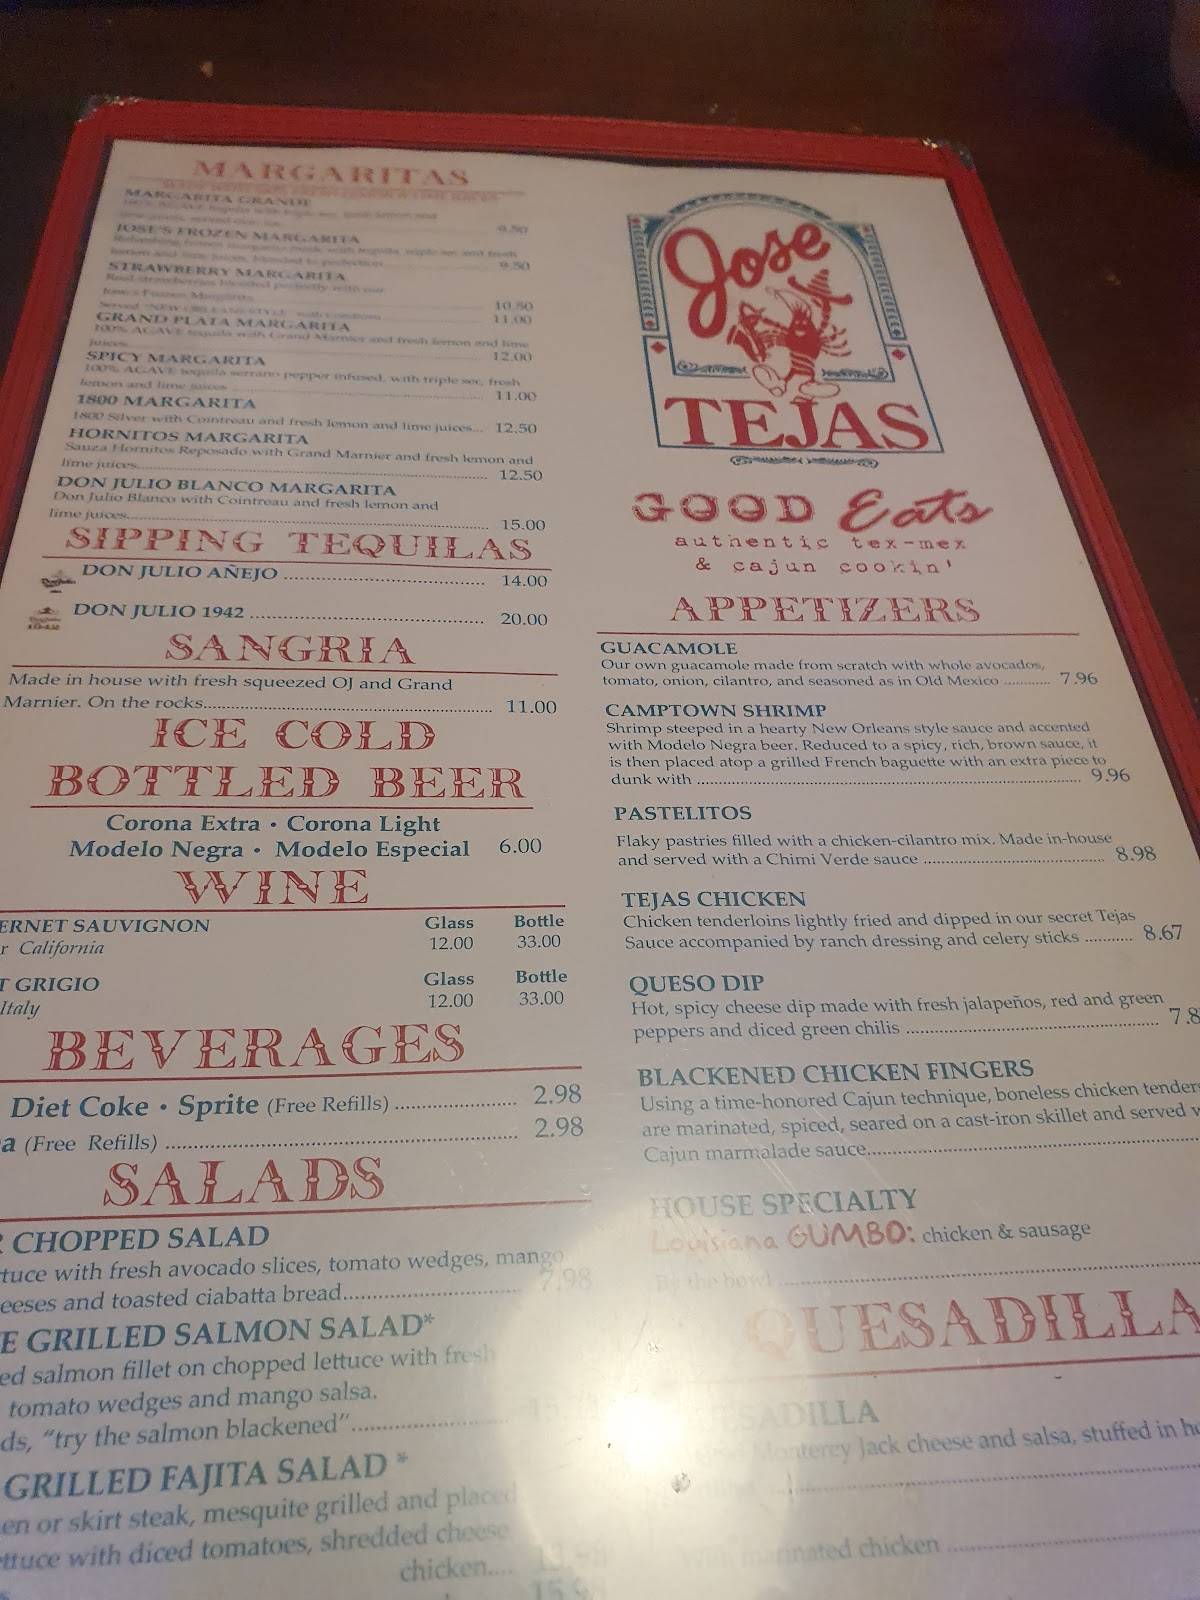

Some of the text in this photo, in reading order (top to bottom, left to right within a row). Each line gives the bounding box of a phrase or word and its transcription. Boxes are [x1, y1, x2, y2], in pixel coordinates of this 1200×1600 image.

[191, 160, 469, 186] MARGARITAS
[107, 261, 347, 282] STRAWBERRY MARGARITA
[664, 223, 830, 338] Jose
[495, 300, 534, 312] 10.50
[96, 312, 351, 332] GRAND PLATA MARGARITA
[86, 351, 266, 366] SPICY MARGARITA
[492, 351, 533, 362] 12.00
[77, 394, 256, 409] 1800 MARGARITA
[496, 391, 537, 401] 11.00
[495, 422, 538, 435] 12.50
[664, 397, 929, 450] TEJAS
[68, 428, 309, 445] HORNITOS MARGARITA
[65, 441, 534, 465] Sauza Hornitos Reposado with Grand Marnier and fresh lemon and
[500, 469, 543, 481] 12.50
[56, 476, 397, 496] DON JULIO BLANCO MARGARITA
[632, 488, 994, 533] GOOD Eats
[502, 519, 546, 531] 15.00
[65, 527, 532, 560] SIPPING TEQUILAS
[675, 533, 966, 550] authentic tex-mex
[82, 564, 547, 587] DON JULIO AÑEJO 14.00
[695, 557, 951, 576] & cajun cookin'
[74, 604, 548, 626] DON JULIO 1942 20.00
[671, 596, 980, 622] APPETIZERS
[165, 634, 414, 664] SANGRIA
[600, 642, 738, 655] GUACAMOLE
[9, 673, 452, 691] Made in house with fresh squeezed OJ and Grand
[1060, 672, 1098, 685] 7.96
[3, 695, 557, 714] Marnier. On the 11.00
[605, 704, 826, 717] CAMPTOWN SHRIMP
[150, 718, 435, 750] ICE COLD
[46, 765, 523, 798] BOTTLED BEER
[611, 772, 692, 786] dunk with
[1091, 768, 1131, 782] 9.96
[614, 806, 752, 820] PASTELITOS
[106, 814, 440, 836] Corona Extra Corona Light
[70, 838, 542, 863] Modelo Negra Modelo Especial 6.00
[1113, 846, 1157, 862] 8.98
[174, 870, 368, 905] WINE
[621, 891, 805, 911] TEJAS CHICKEN
[73, 919, 210, 933] SAUVIGNON
[425, 914, 564, 929] Glass Bottle
[622, 909, 1136, 931] Chicken tenderloins lightly fried and dipped in our secret Tejas
[430, 934, 561, 950] 12.00 33.00
[1143, 924, 1182, 941] 8.67
[19, 940, 105, 959] California
[15, 977, 100, 992] GRIGIO
[424, 969, 567, 986] Glass Bottle
[629, 975, 764, 997] QUESO DIP
[429, 991, 564, 1008] 12.00 33.00
[42, 1024, 465, 1071] BEVERAGES
[637, 1059, 1034, 1087] BLACKENED CHICKEN FINGERS
[11, 1084, 582, 1120] Diet Coke Sprite (Free Refills) 2.98
[25, 1116, 584, 1156] (Free Refills) 2.98
[103, 1157, 384, 1206] SALADS
[652, 1188, 917, 1219] HOUSE SPECIALTY
[12, 1226, 269, 1254] CHOPPED SALAD
[787, 1219, 915, 1249] GUMBO:
[922, 1225, 994, 1243] chicken
[998, 1223, 1015, 1239] &
[1018, 1224, 1091, 1241] sausage
[27, 1324, 166, 1353] GRILLED
[174, 1318, 311, 1346] SALMON
[8, 1381, 377, 1418] tomato wedges and mango salsa.
[3, 1453, 387, 1501] GRILLED FAJITA SALAD
